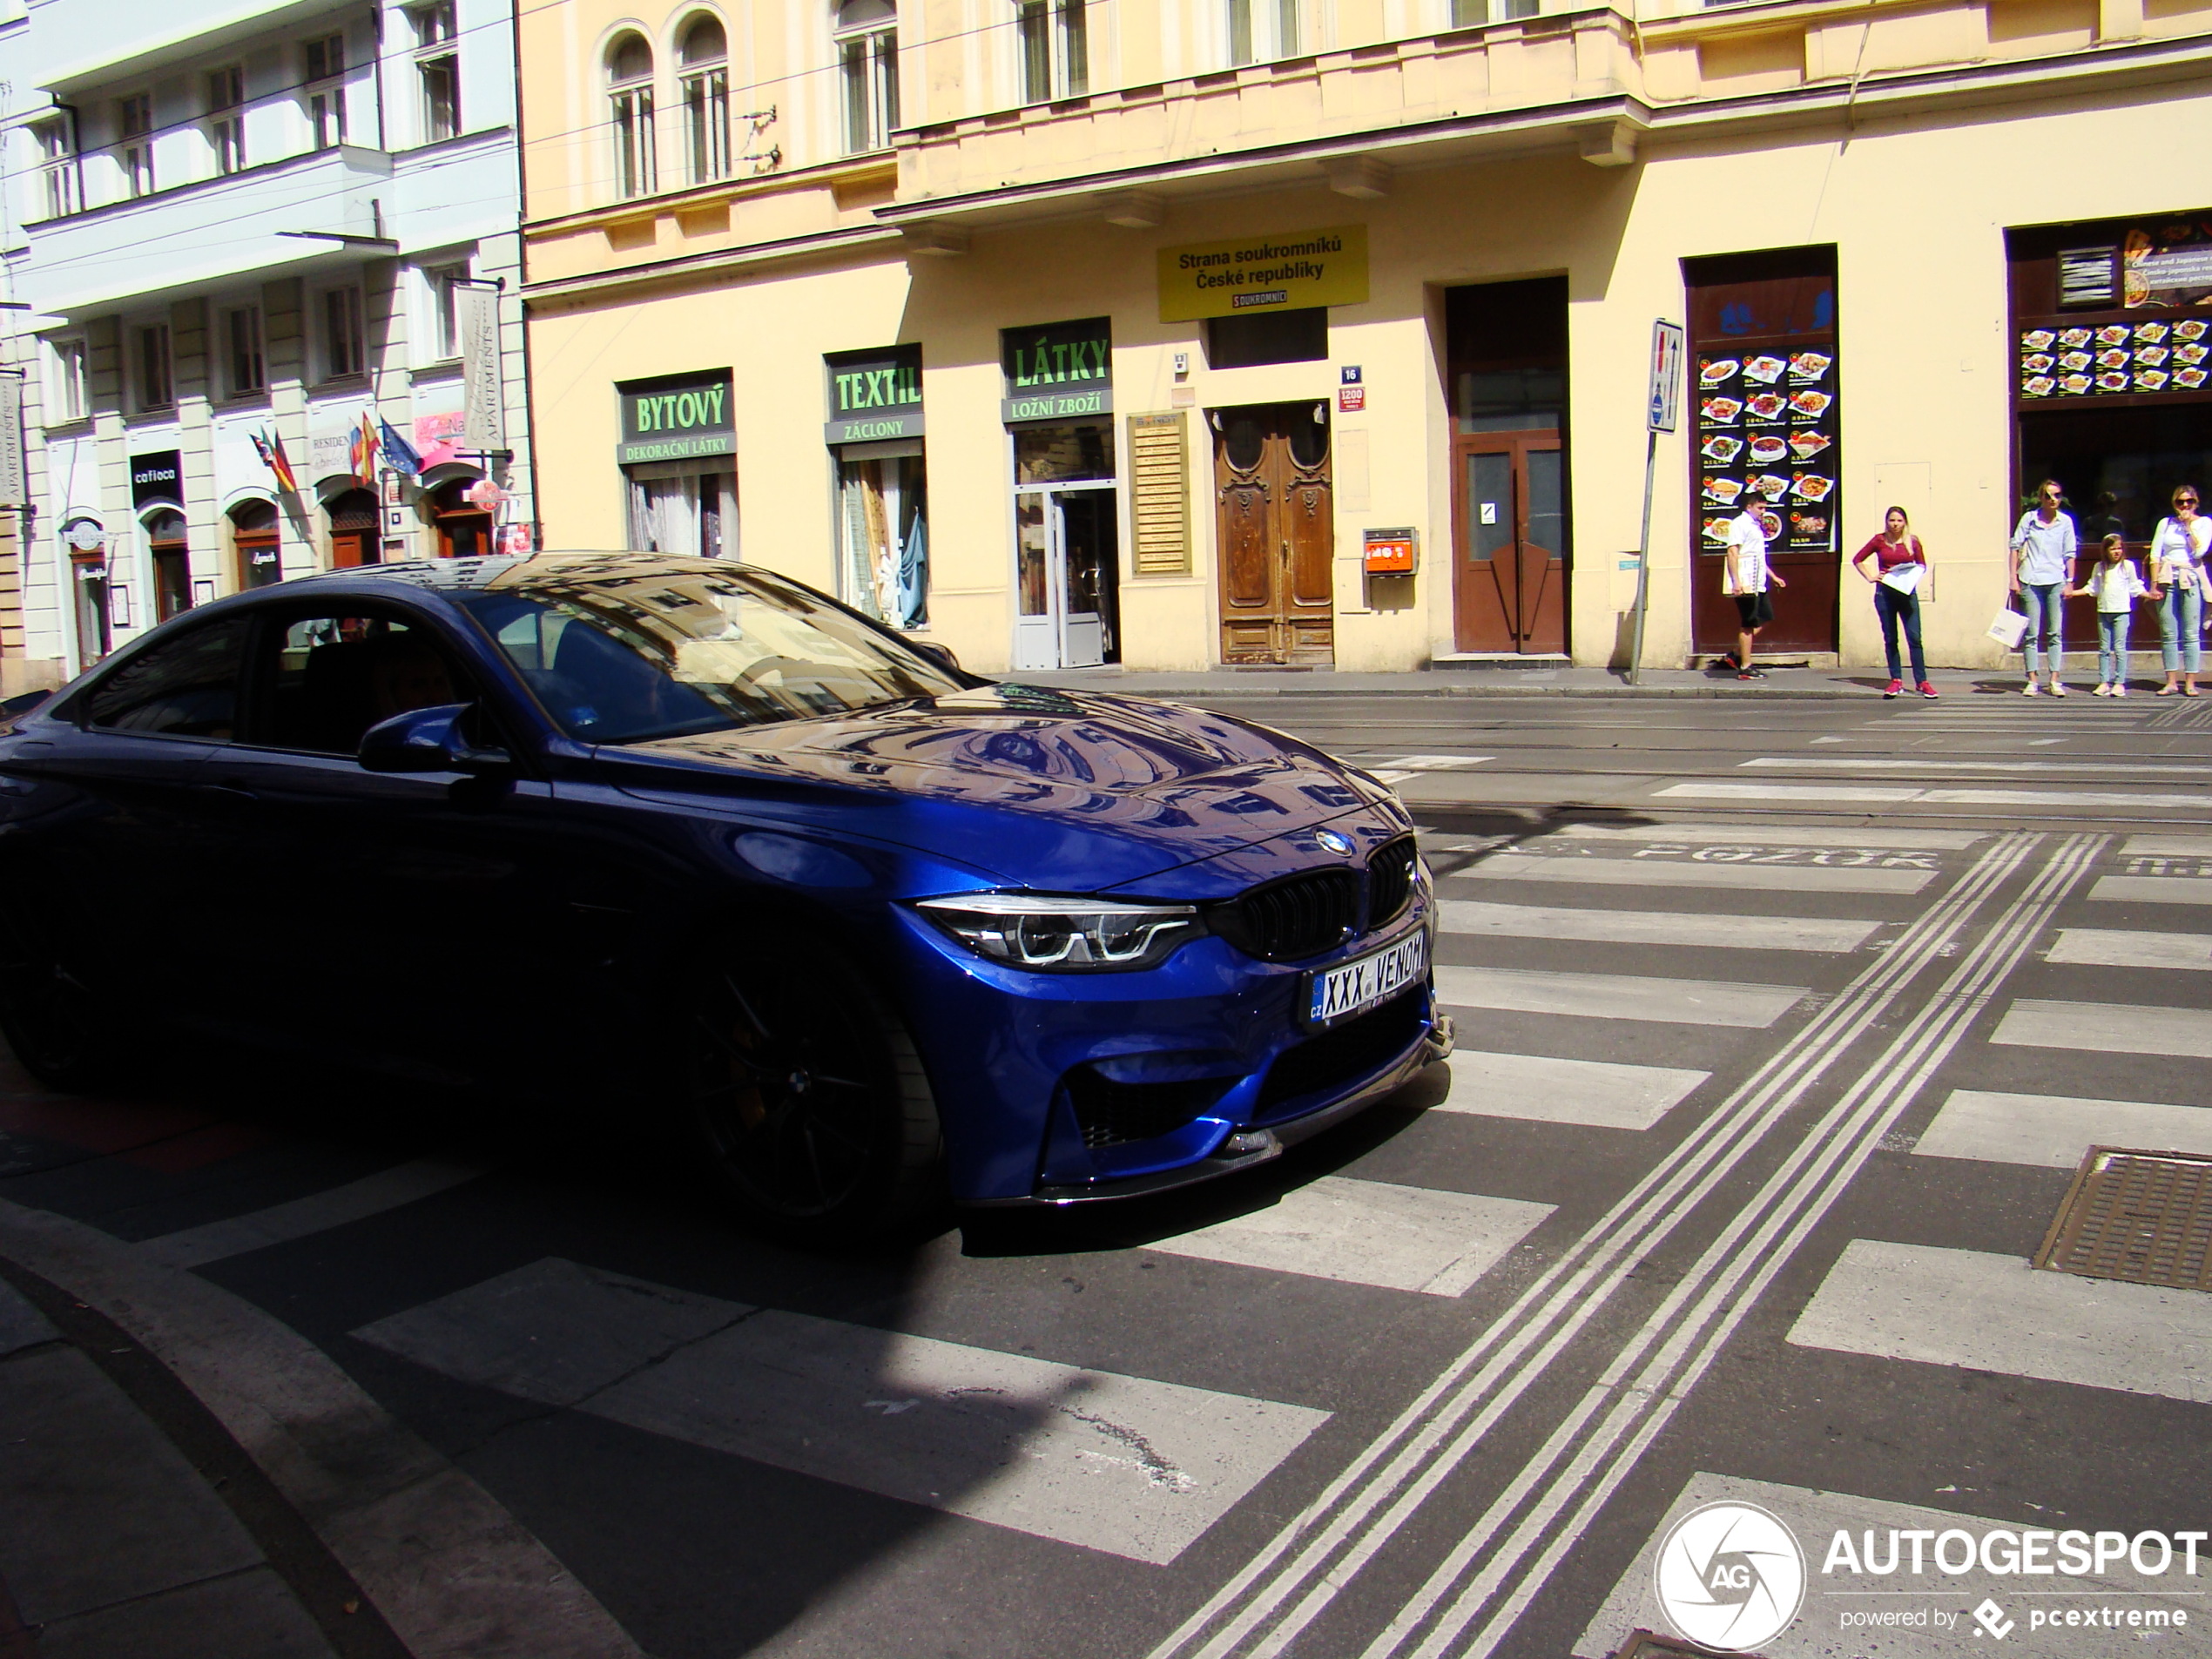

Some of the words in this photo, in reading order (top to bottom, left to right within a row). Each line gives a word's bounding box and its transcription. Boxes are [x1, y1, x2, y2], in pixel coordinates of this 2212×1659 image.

[1179, 253, 1231, 269] Strana
[1235, 235, 1342, 263] soukromníků
[1197, 269, 1244, 288] České
[1249, 261, 1324, 286] republiky
[1015, 336, 1108, 388] LÁTKY
[1345, 369, 1357, 381] 16
[483, 326, 498, 442] APARTMENTS
[836, 367, 922, 411] TEXTIL
[1341, 389, 1363, 401] 1200
[637, 381, 725, 433] BYTOVÝ
[1011, 396, 1055, 418] LOŽNÍ
[1058, 391, 1102, 415] ZBOŽÍ
[844, 421, 903, 440] ZÁCLONY
[4, 405, 20, 497] APARTMENTS
[626, 438, 691, 461] DEKORAČNÍ
[692, 436, 728, 454] LÁTKY
[135, 469, 176, 484] cafioca
[1325, 964, 1366, 1015] XXX
[1377, 934, 1425, 993] VENOM
[1310, 1004, 1323, 1019] CZ
